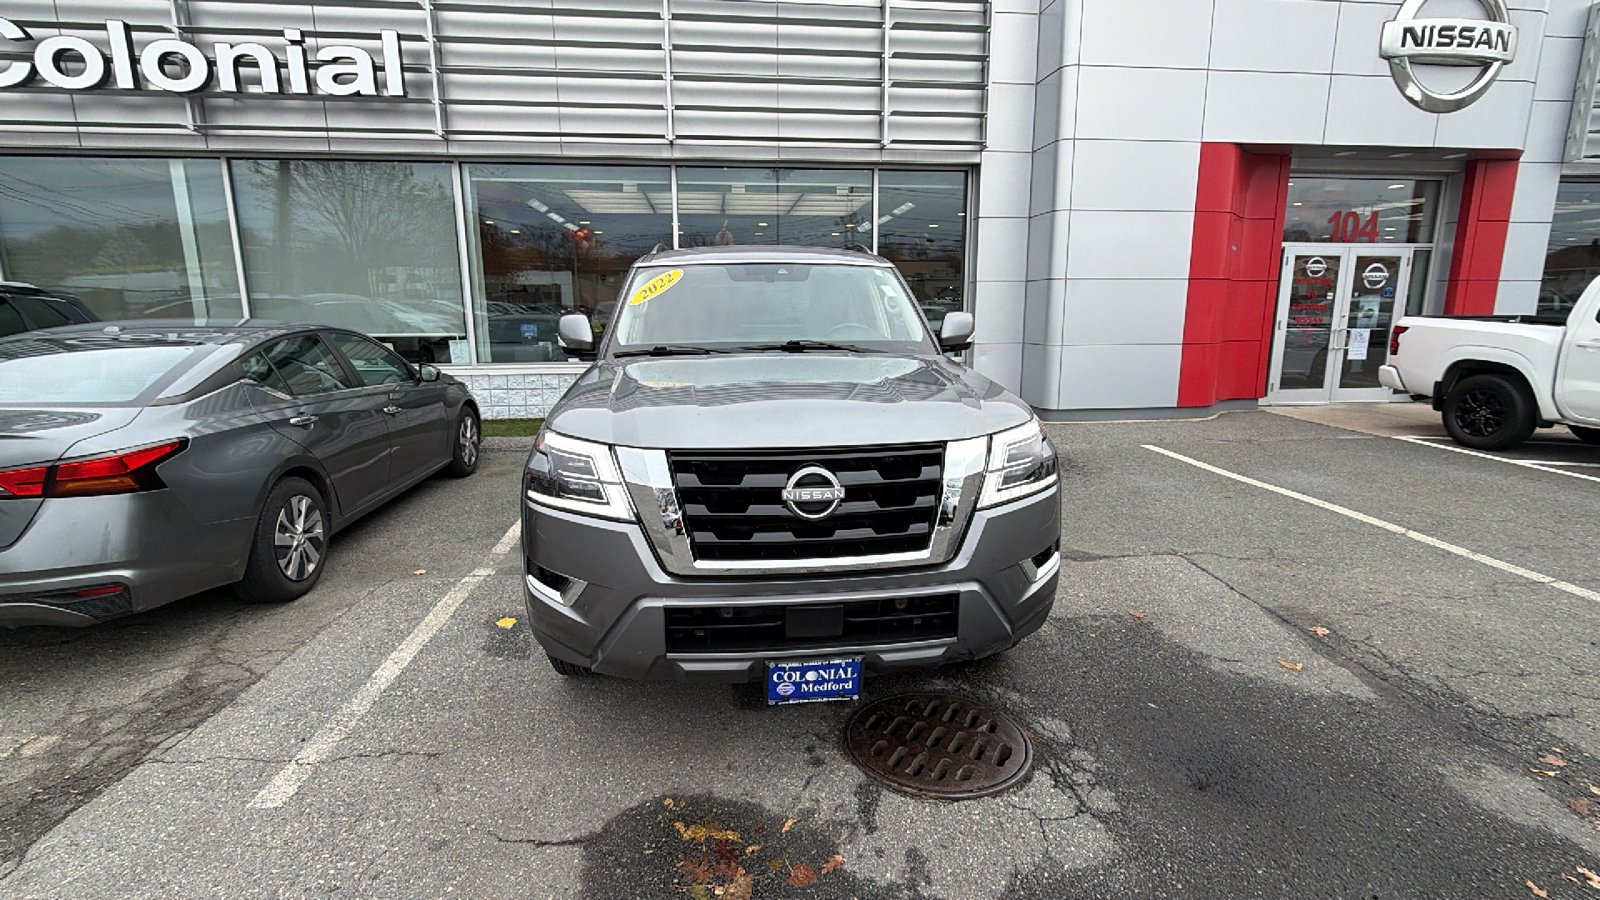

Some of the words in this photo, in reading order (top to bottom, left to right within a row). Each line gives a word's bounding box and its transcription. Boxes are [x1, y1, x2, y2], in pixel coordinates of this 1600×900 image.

[1400, 25, 1512, 53] NISSAN
[1327, 210, 1379, 243] 104
[640, 274, 674, 299] 2022
[783, 489, 844, 500] NISSAN
[773, 668, 857, 683] COLONIAL
[801, 681, 852, 692] Medford
